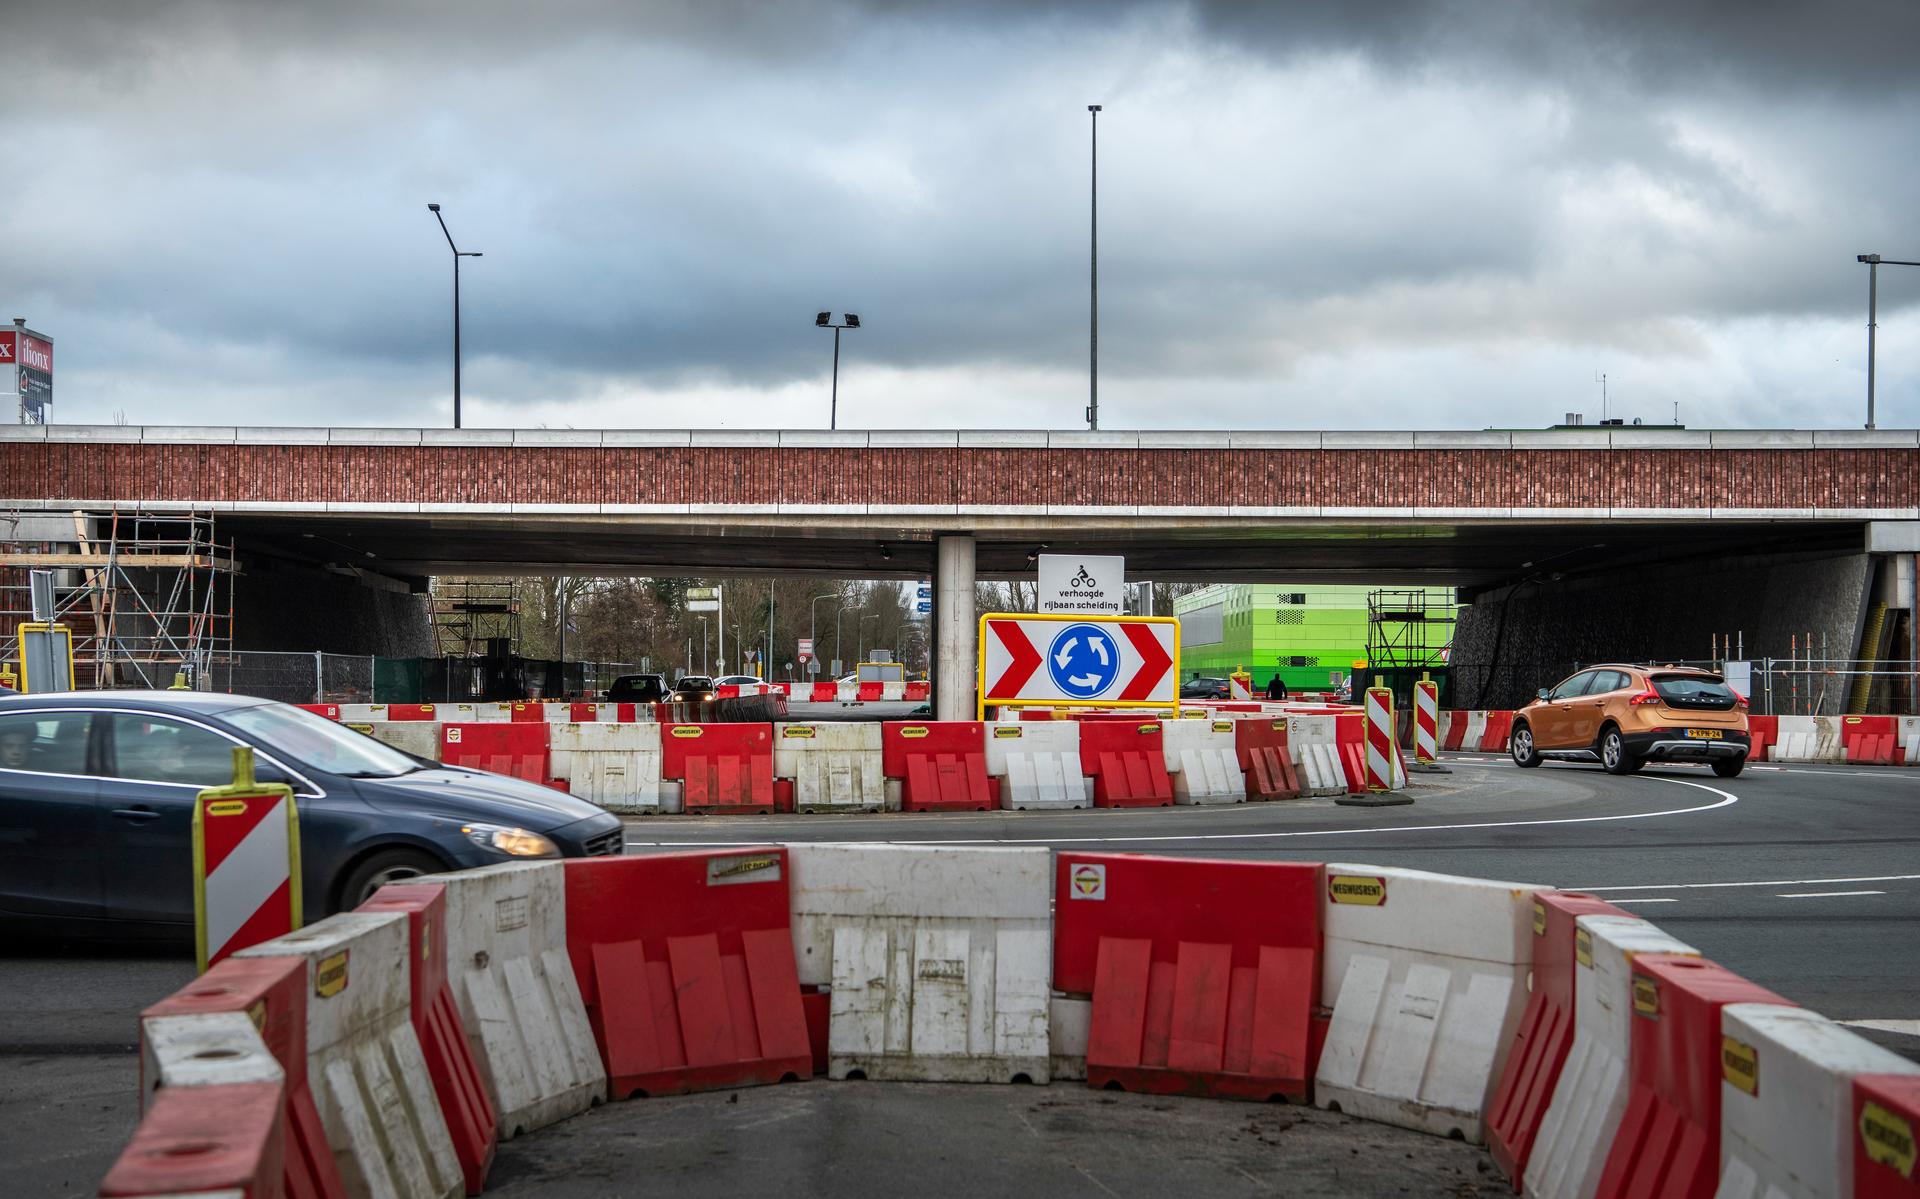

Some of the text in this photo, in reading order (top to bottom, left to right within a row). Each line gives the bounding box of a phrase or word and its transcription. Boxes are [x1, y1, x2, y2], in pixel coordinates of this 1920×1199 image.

[23, 339, 48, 369] ilionx
[1059, 589, 1104, 599] verhoogde
[1044, 600, 1119, 611] rijbaan scheiding
[1688, 729, 1720, 738] 9-KPN-24
